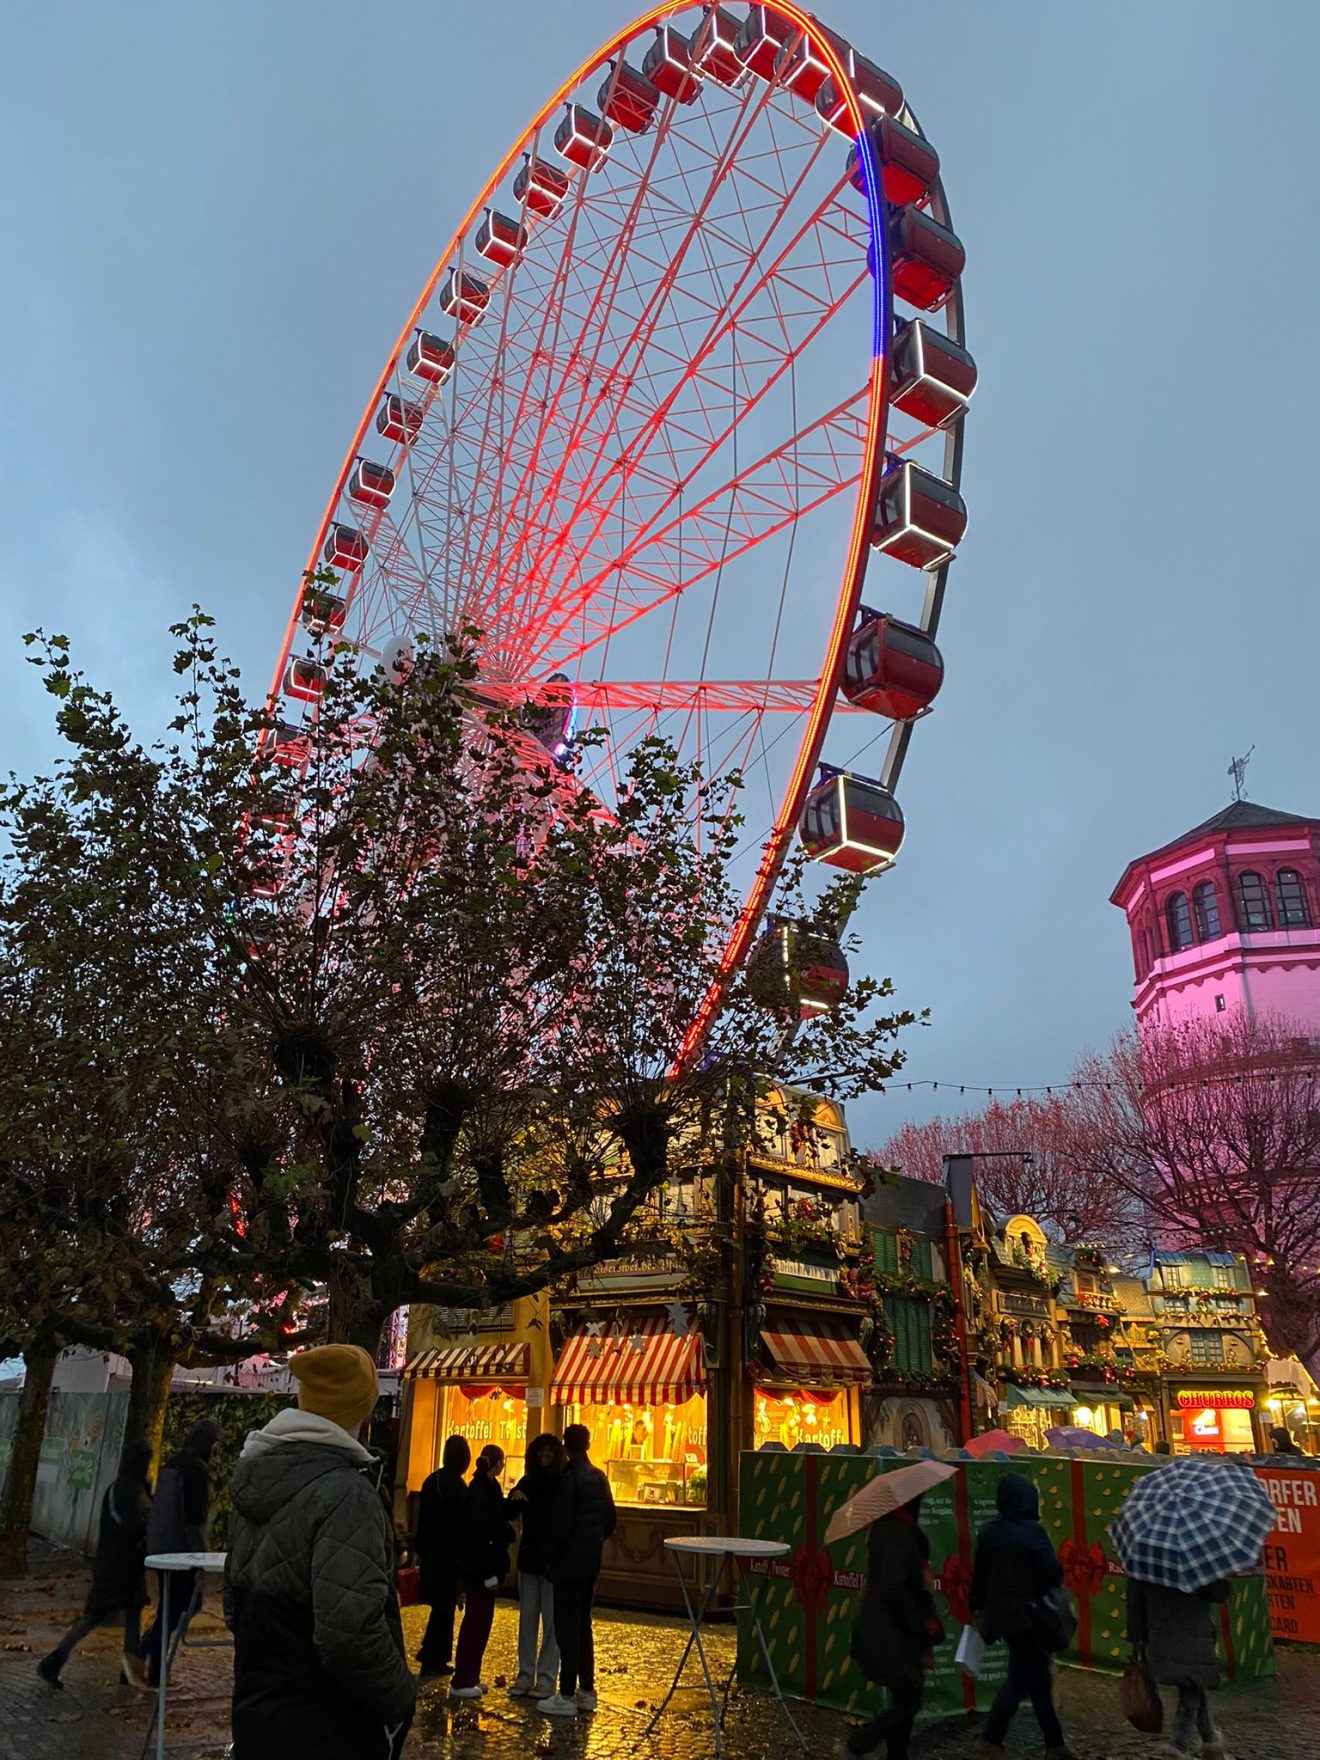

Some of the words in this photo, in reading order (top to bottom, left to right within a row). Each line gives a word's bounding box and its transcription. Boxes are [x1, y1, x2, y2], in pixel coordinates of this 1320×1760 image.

[1177, 1390, 1255, 1409] CHURROS
[1272, 1506, 1302, 1534] EN
[1264, 1545, 1288, 1572] ER
